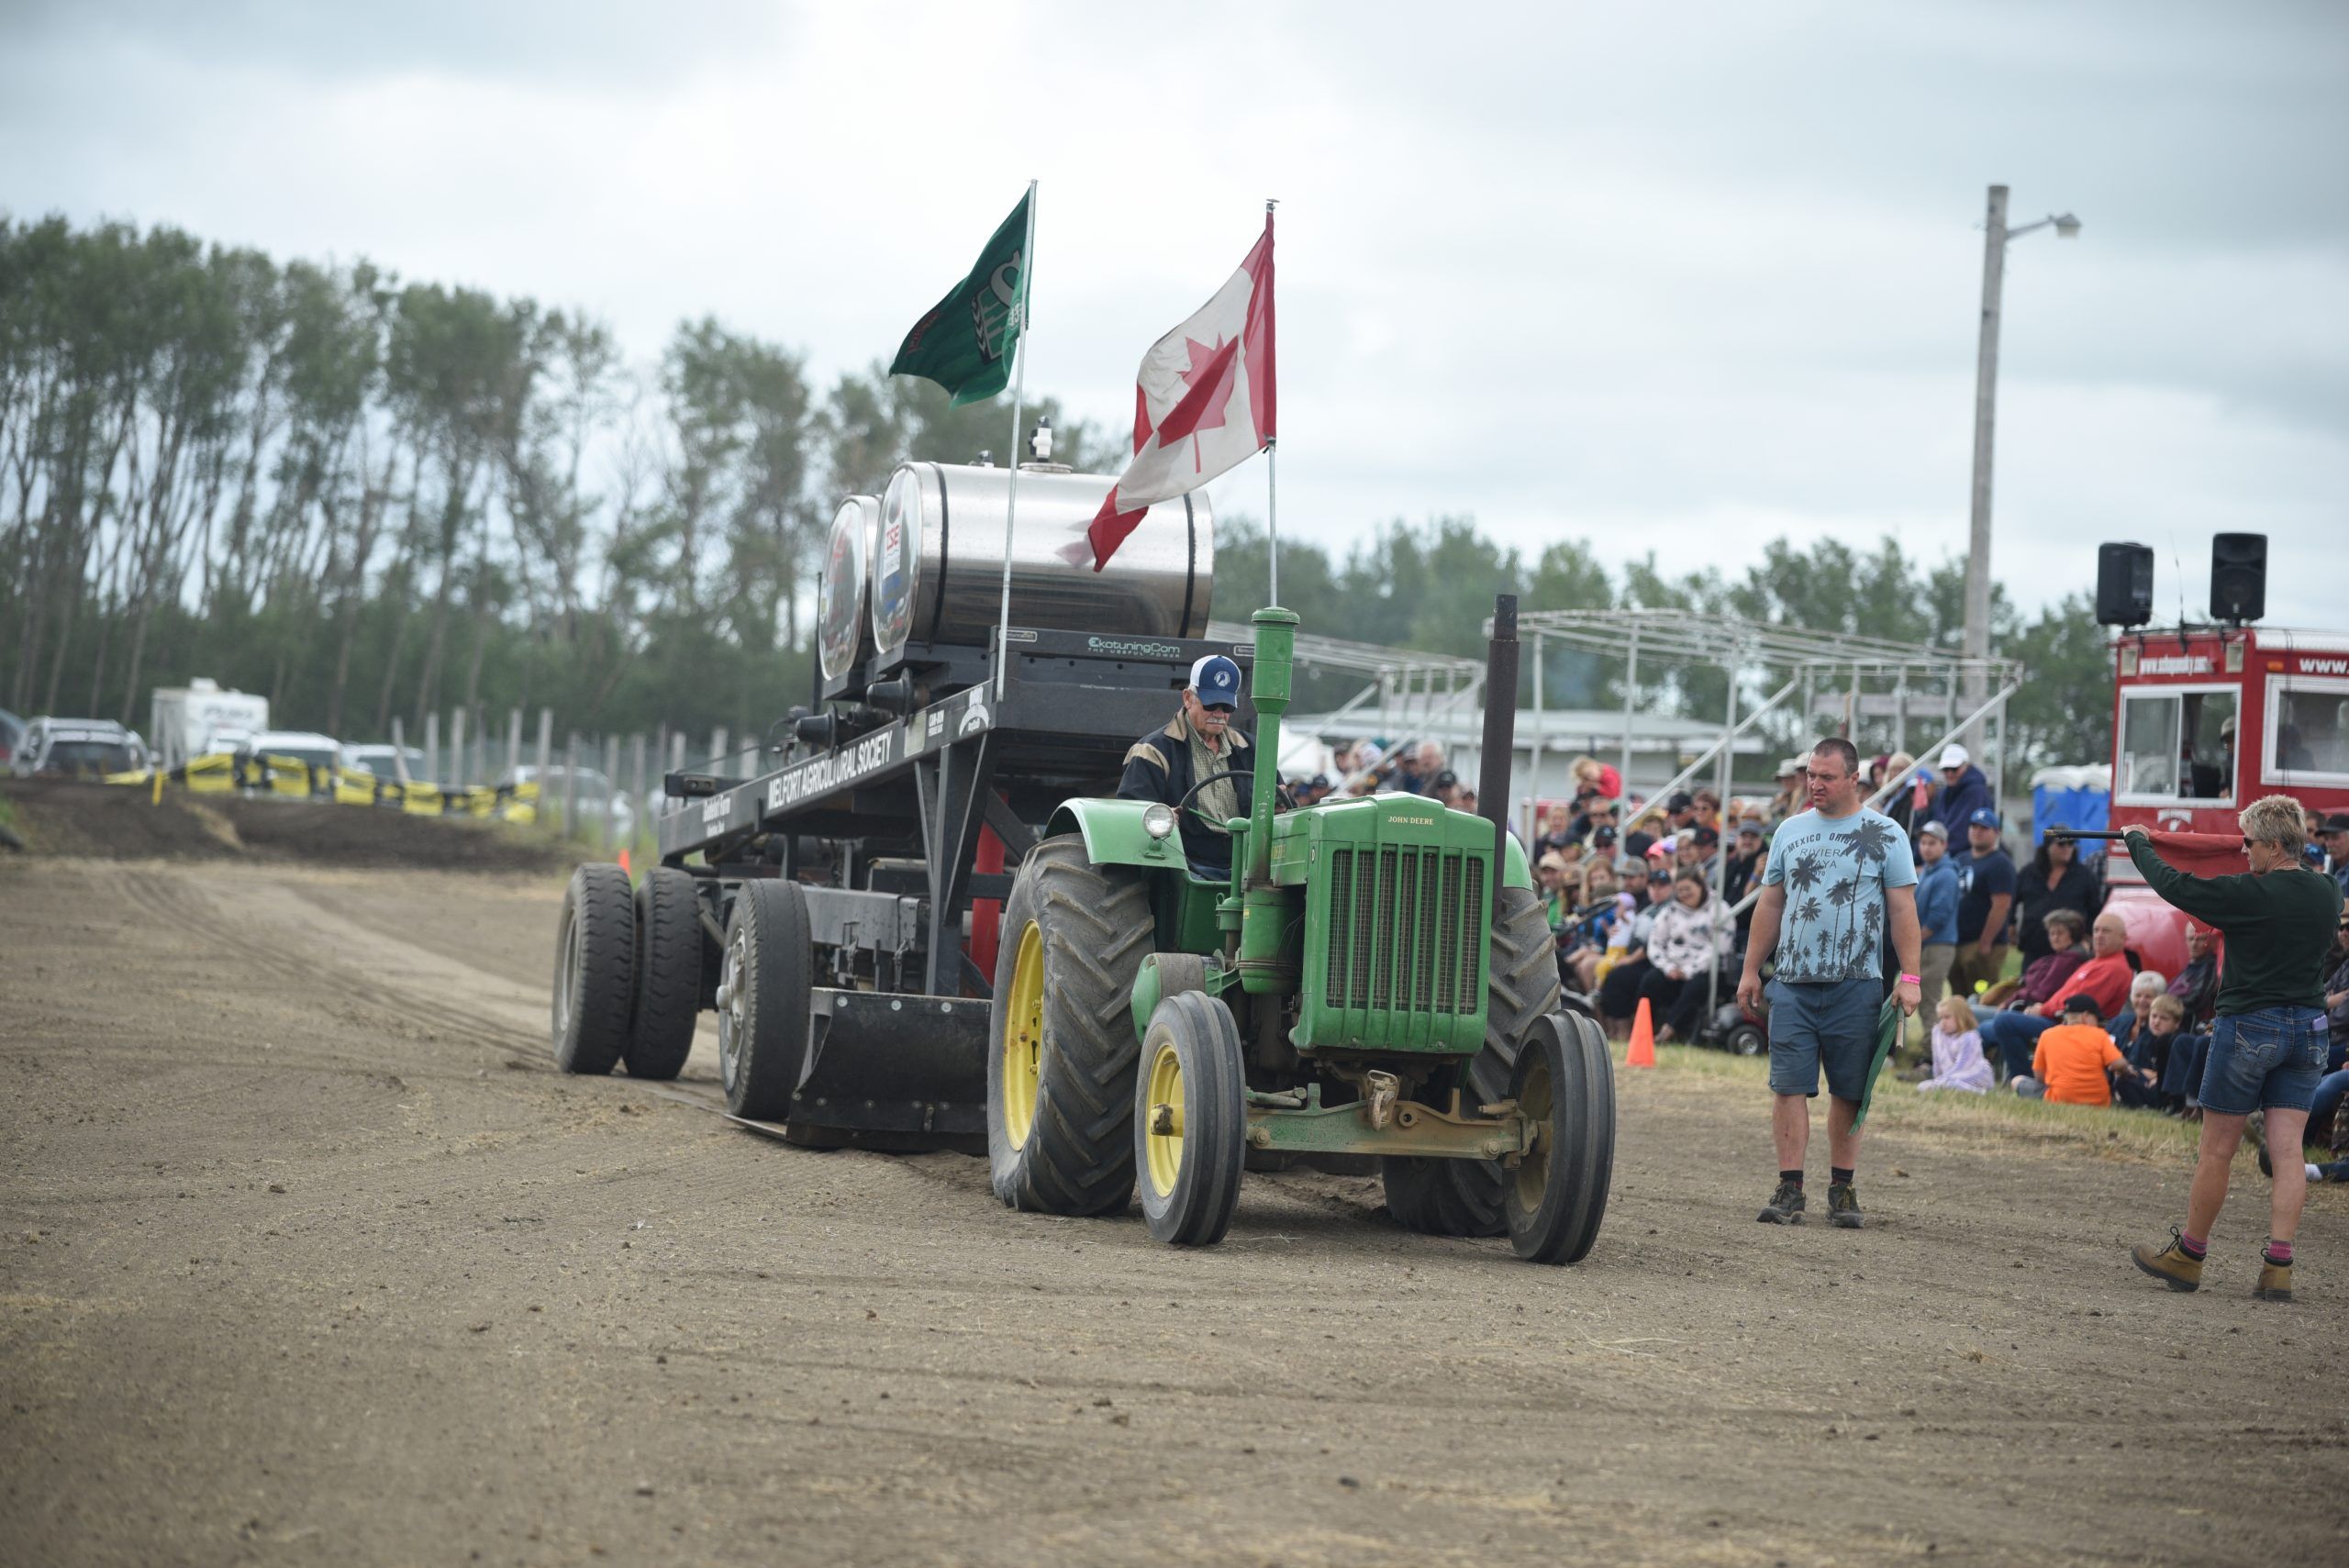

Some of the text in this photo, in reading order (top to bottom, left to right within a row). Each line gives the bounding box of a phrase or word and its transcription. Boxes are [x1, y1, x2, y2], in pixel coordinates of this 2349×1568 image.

[768, 769, 803, 810] MELFORT
[857, 730, 893, 774] SOCIETY
[1409, 817, 1434, 826] DEERE
[1787, 833, 1820, 853] MEXICO
[1807, 860, 1837, 869] AYA
